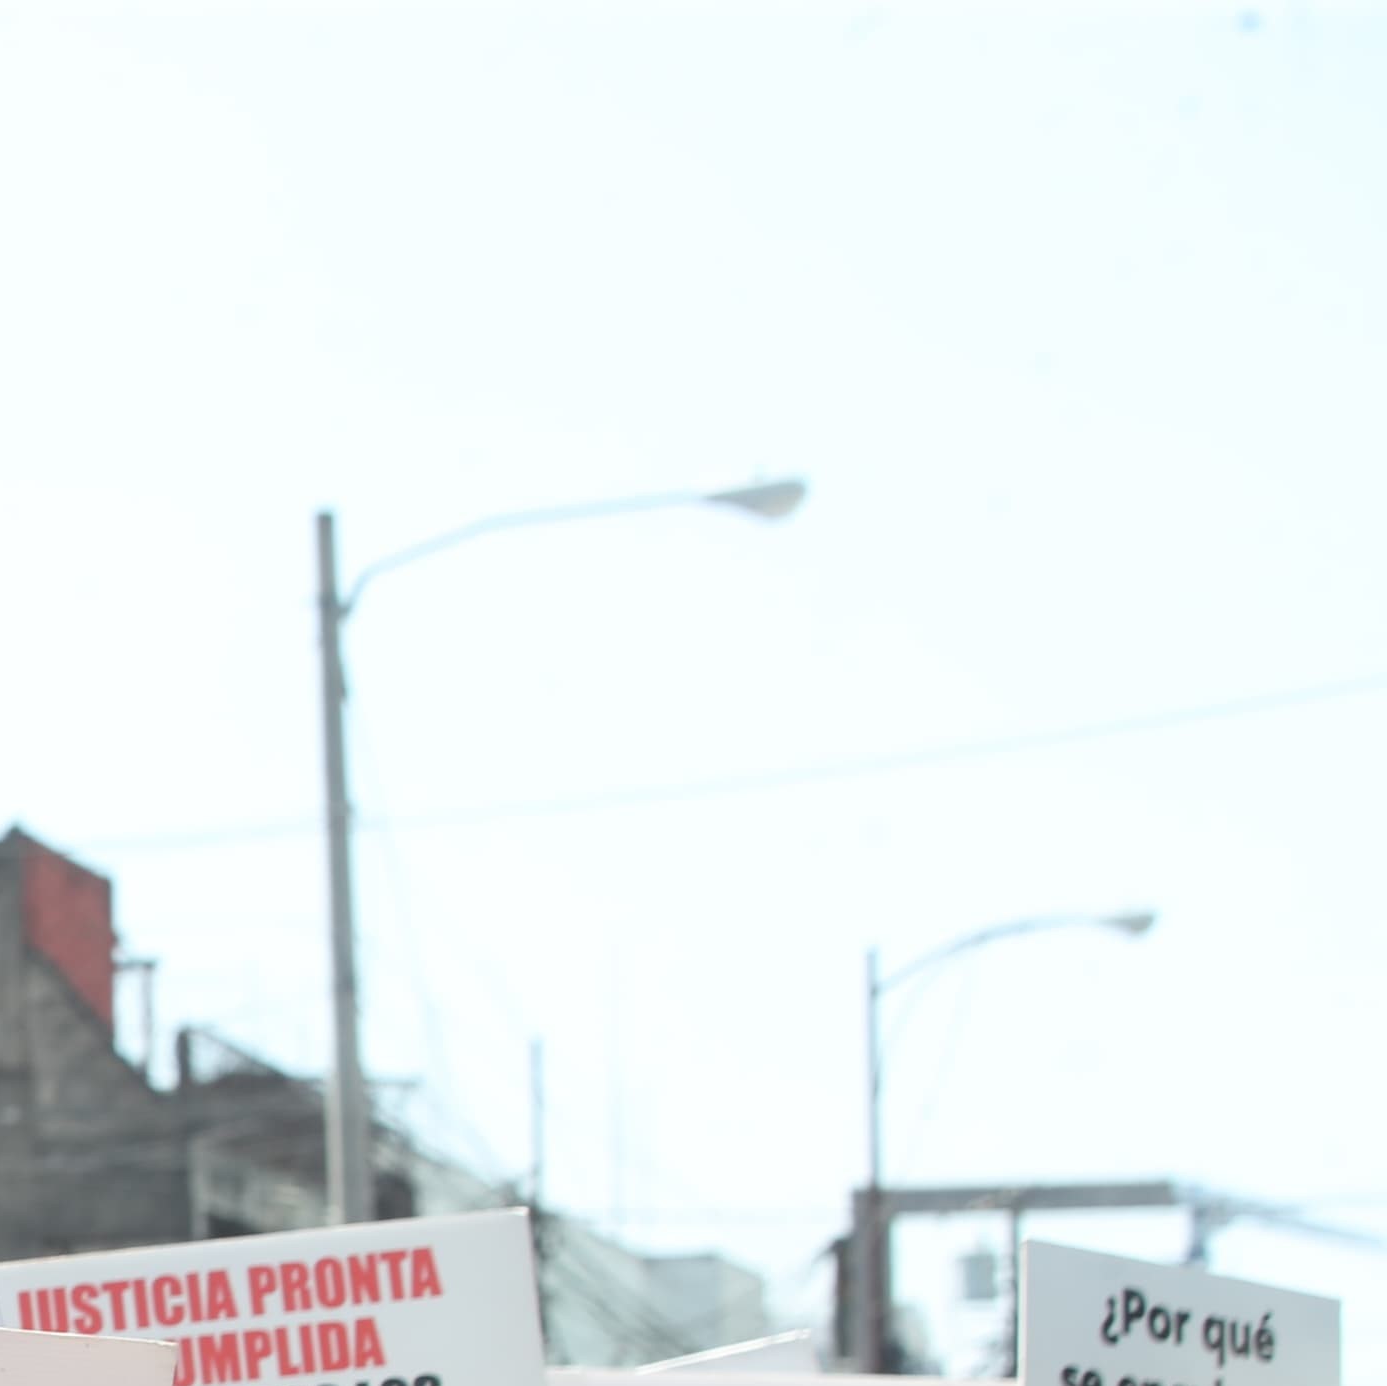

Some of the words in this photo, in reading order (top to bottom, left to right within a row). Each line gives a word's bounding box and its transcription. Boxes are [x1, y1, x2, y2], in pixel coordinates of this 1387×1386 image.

[17, 1269, 239, 1336] JUSTICIA
[245, 1245, 444, 1316] PRONTA
[1100, 1288, 1190, 1345] ¿Por
[1202, 1311, 1276, 1368] qué
